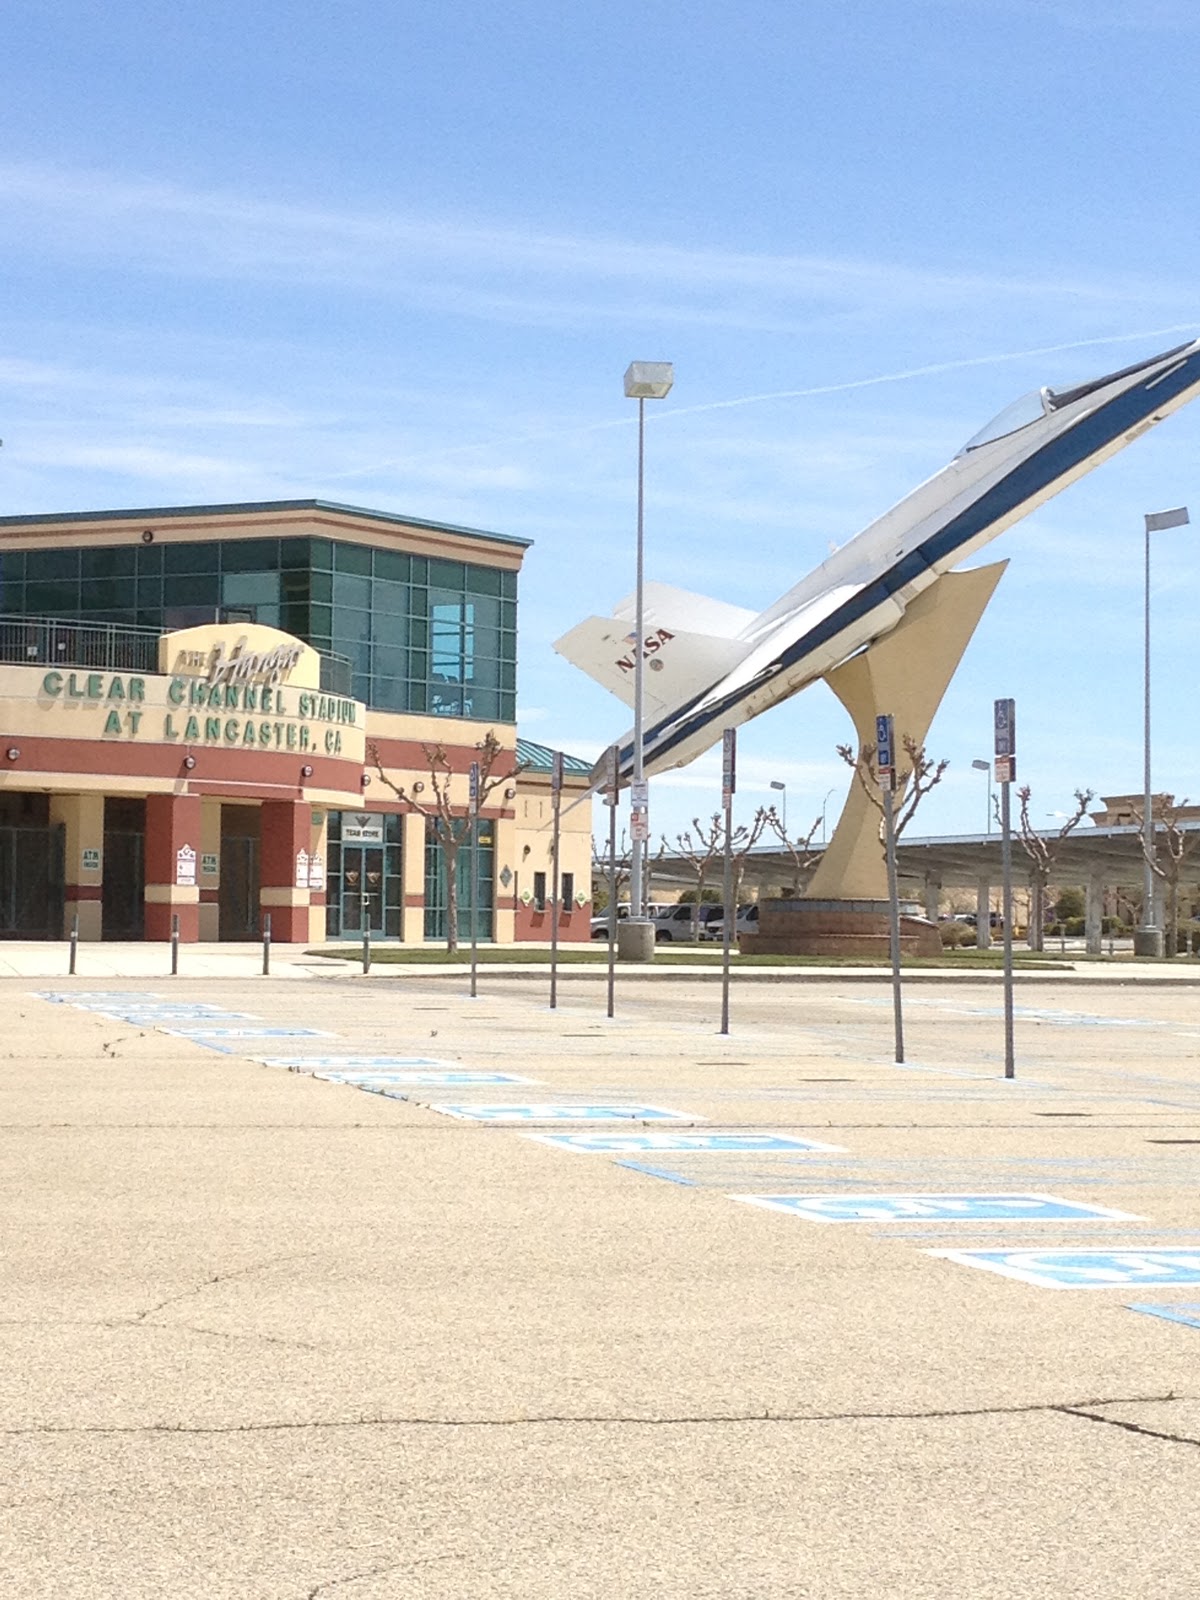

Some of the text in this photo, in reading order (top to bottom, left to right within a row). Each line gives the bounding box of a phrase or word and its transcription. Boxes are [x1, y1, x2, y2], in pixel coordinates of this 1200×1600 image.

[43, 671, 356, 724] CLEAR CHANNEL STADIUM
[104, 710, 342, 755] AT LANCASTER, CA
[83, 850, 99, 860] ATM
